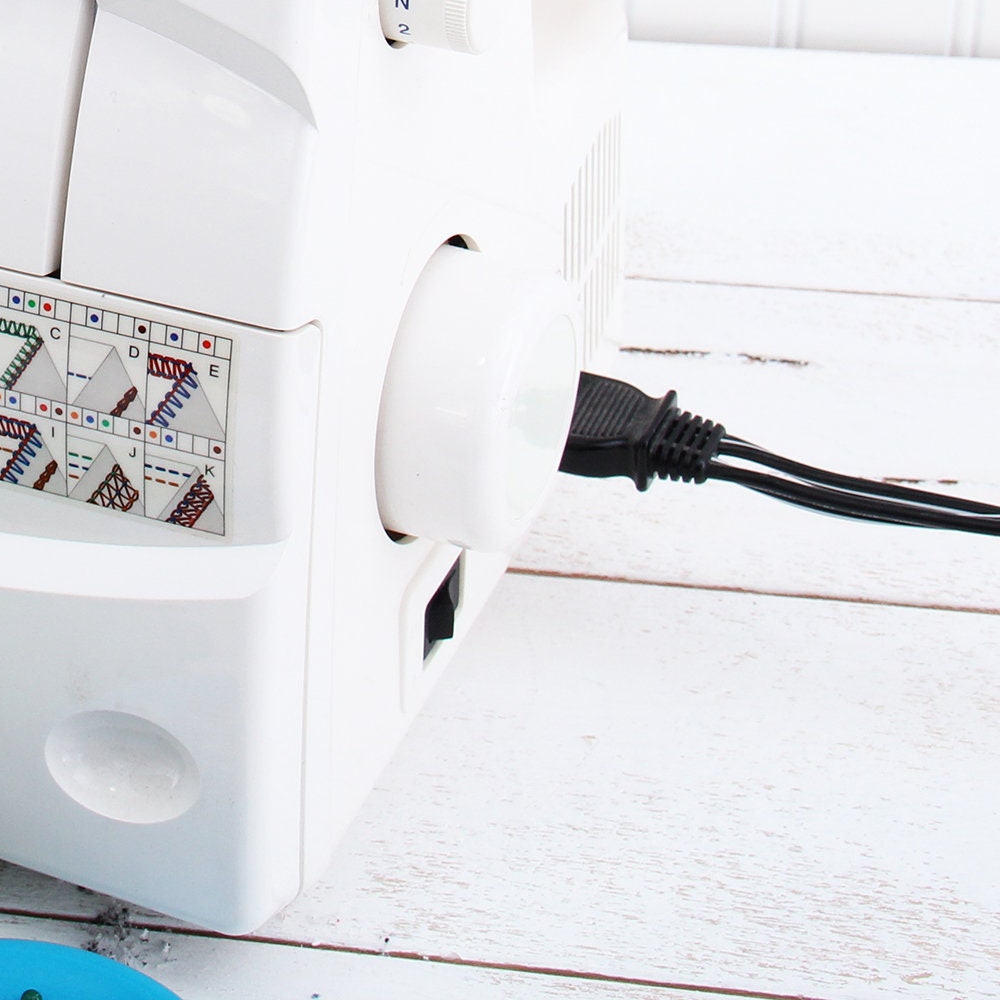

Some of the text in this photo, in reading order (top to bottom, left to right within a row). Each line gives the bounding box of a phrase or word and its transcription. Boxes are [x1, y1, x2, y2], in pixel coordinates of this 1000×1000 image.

[397, 23, 412, 36] 2
[50, 327, 61, 340] C
[129, 345, 140, 359] D
[209, 364, 219, 378] E
[129, 446, 137, 458] J
[205, 464, 215, 477] K
